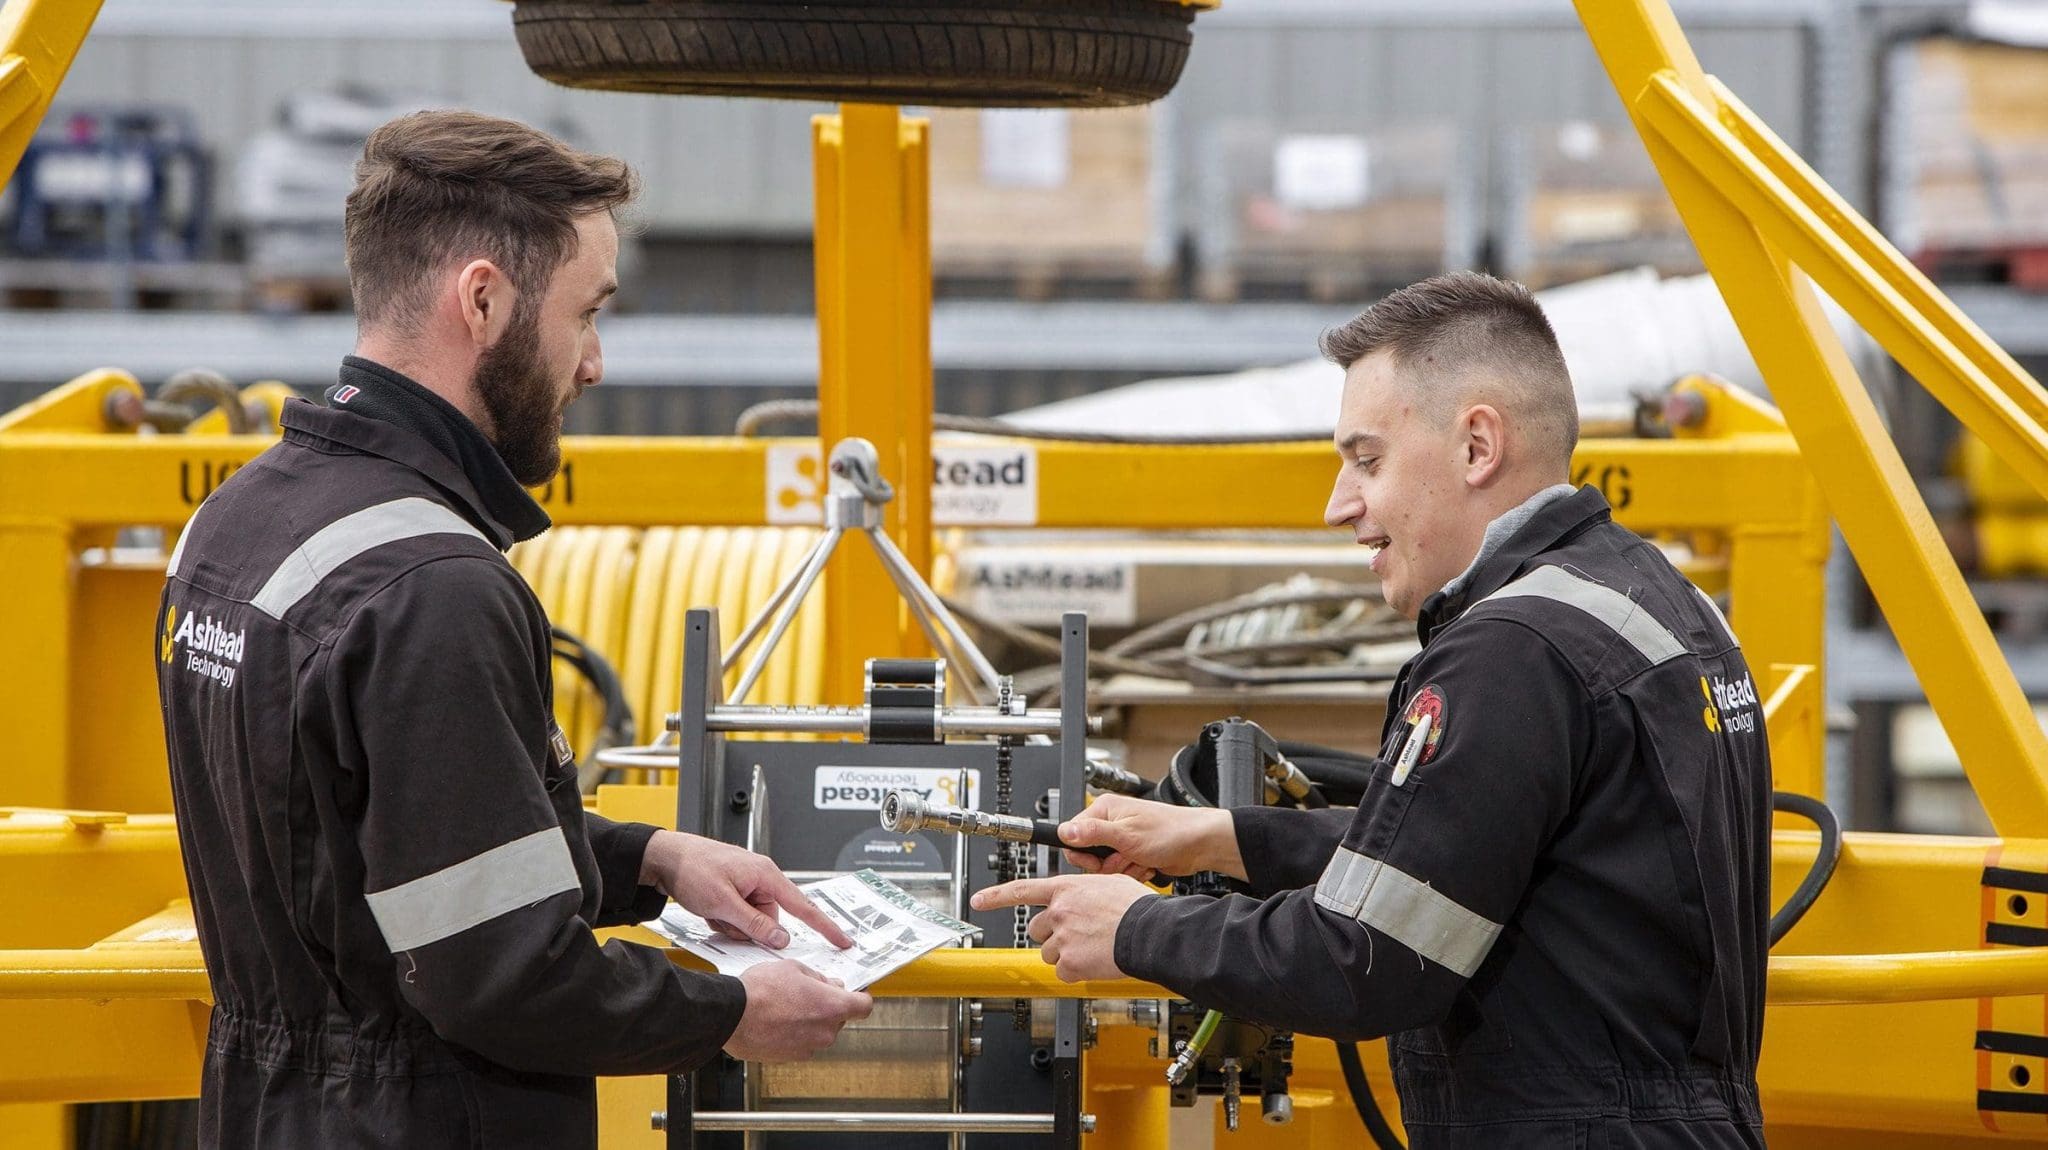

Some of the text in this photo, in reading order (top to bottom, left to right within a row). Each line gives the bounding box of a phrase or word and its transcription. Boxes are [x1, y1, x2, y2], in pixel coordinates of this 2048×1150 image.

[934, 455, 1025, 486] tead
[174, 610, 245, 663] Ashtead
[186, 649, 236, 688] Technology
[837, 771, 919, 786] Technology
